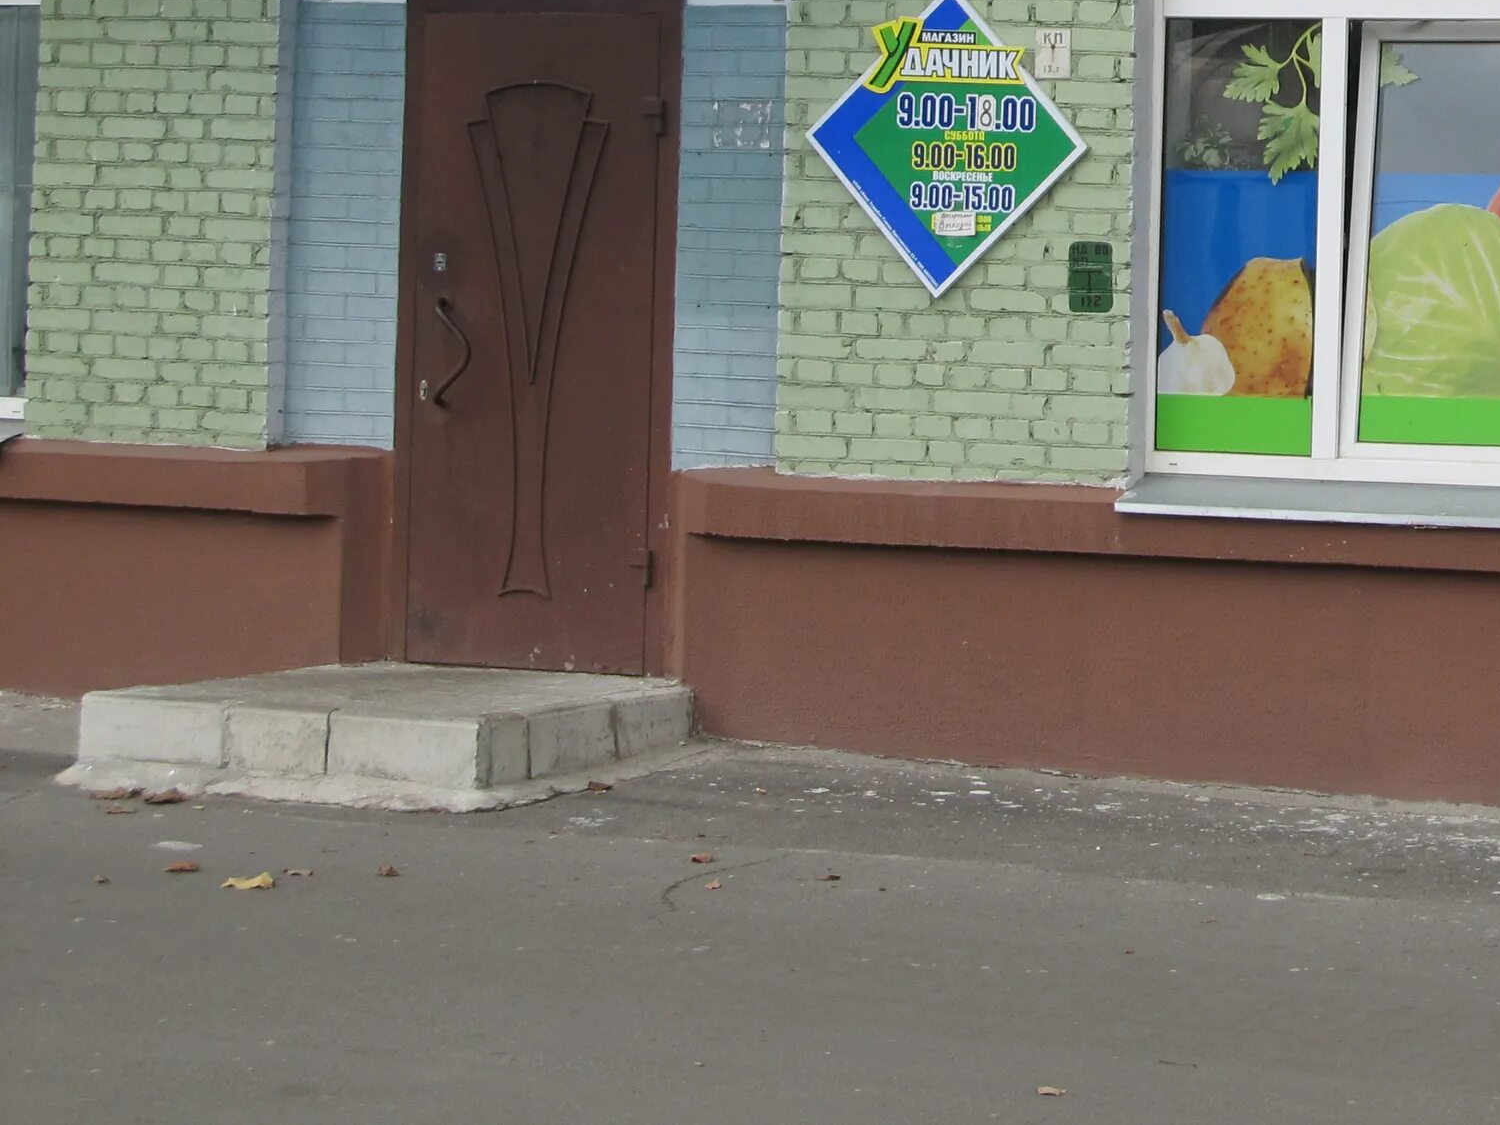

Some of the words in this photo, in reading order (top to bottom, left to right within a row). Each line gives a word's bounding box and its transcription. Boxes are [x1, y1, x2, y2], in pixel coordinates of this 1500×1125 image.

[921, 31, 975, 44] МАГАЗИН
[1043, 32, 1063, 44] КП
[870, 20, 1018, 87] УДАЧНИК
[897, 92, 1036, 132] 9.00-18.00
[944, 130, 985, 141] СУББОТА
[912, 142, 1016, 171] 9.00-16.00
[932, 172, 993, 182] ВОСКРЕСЕНЬЕ
[910, 182, 1015, 212] 9.00-15.00
